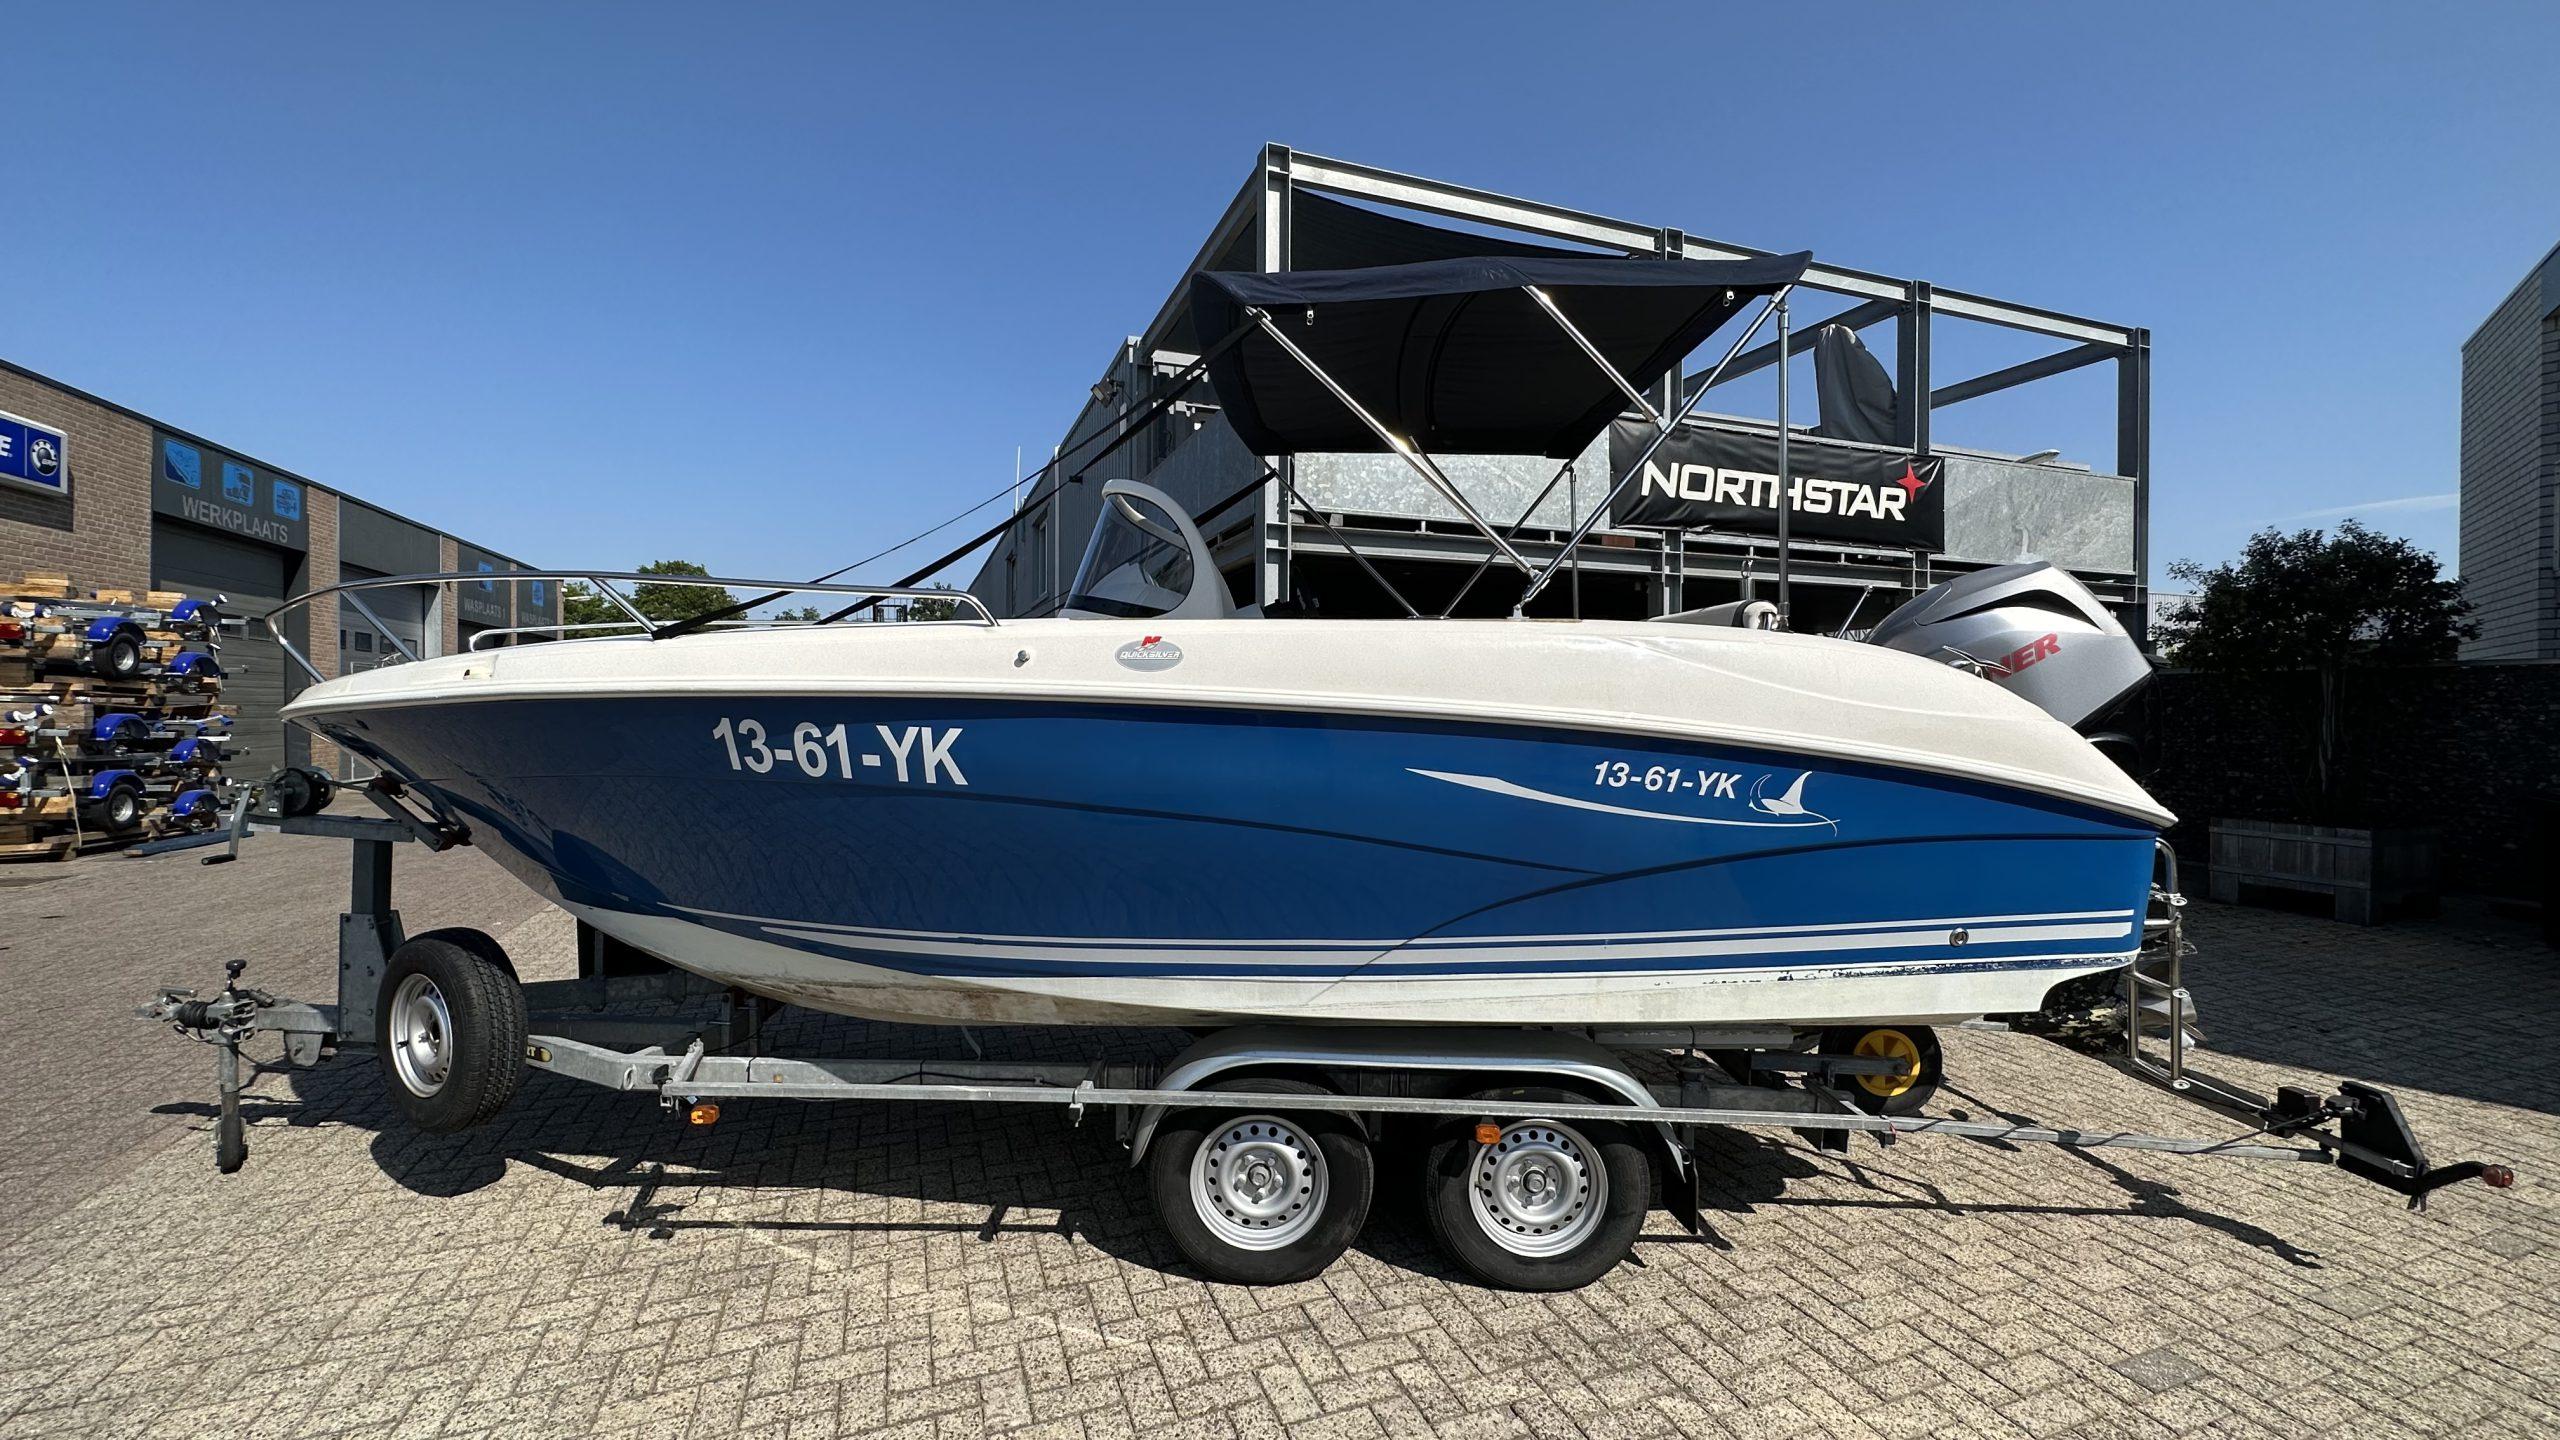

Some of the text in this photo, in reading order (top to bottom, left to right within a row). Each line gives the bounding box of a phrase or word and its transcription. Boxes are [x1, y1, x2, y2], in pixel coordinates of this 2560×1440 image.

[1641, 460, 1906, 521] NORTHSTAR
[182, 495, 288, 543] WERKPLAATS
[464, 597, 501, 618] WASPLAATS
[1120, 651, 1180, 659] QUICKSILVER
[713, 717, 969, 785] 13-61-YK
[1594, 760, 1742, 799] 13-61-YK
